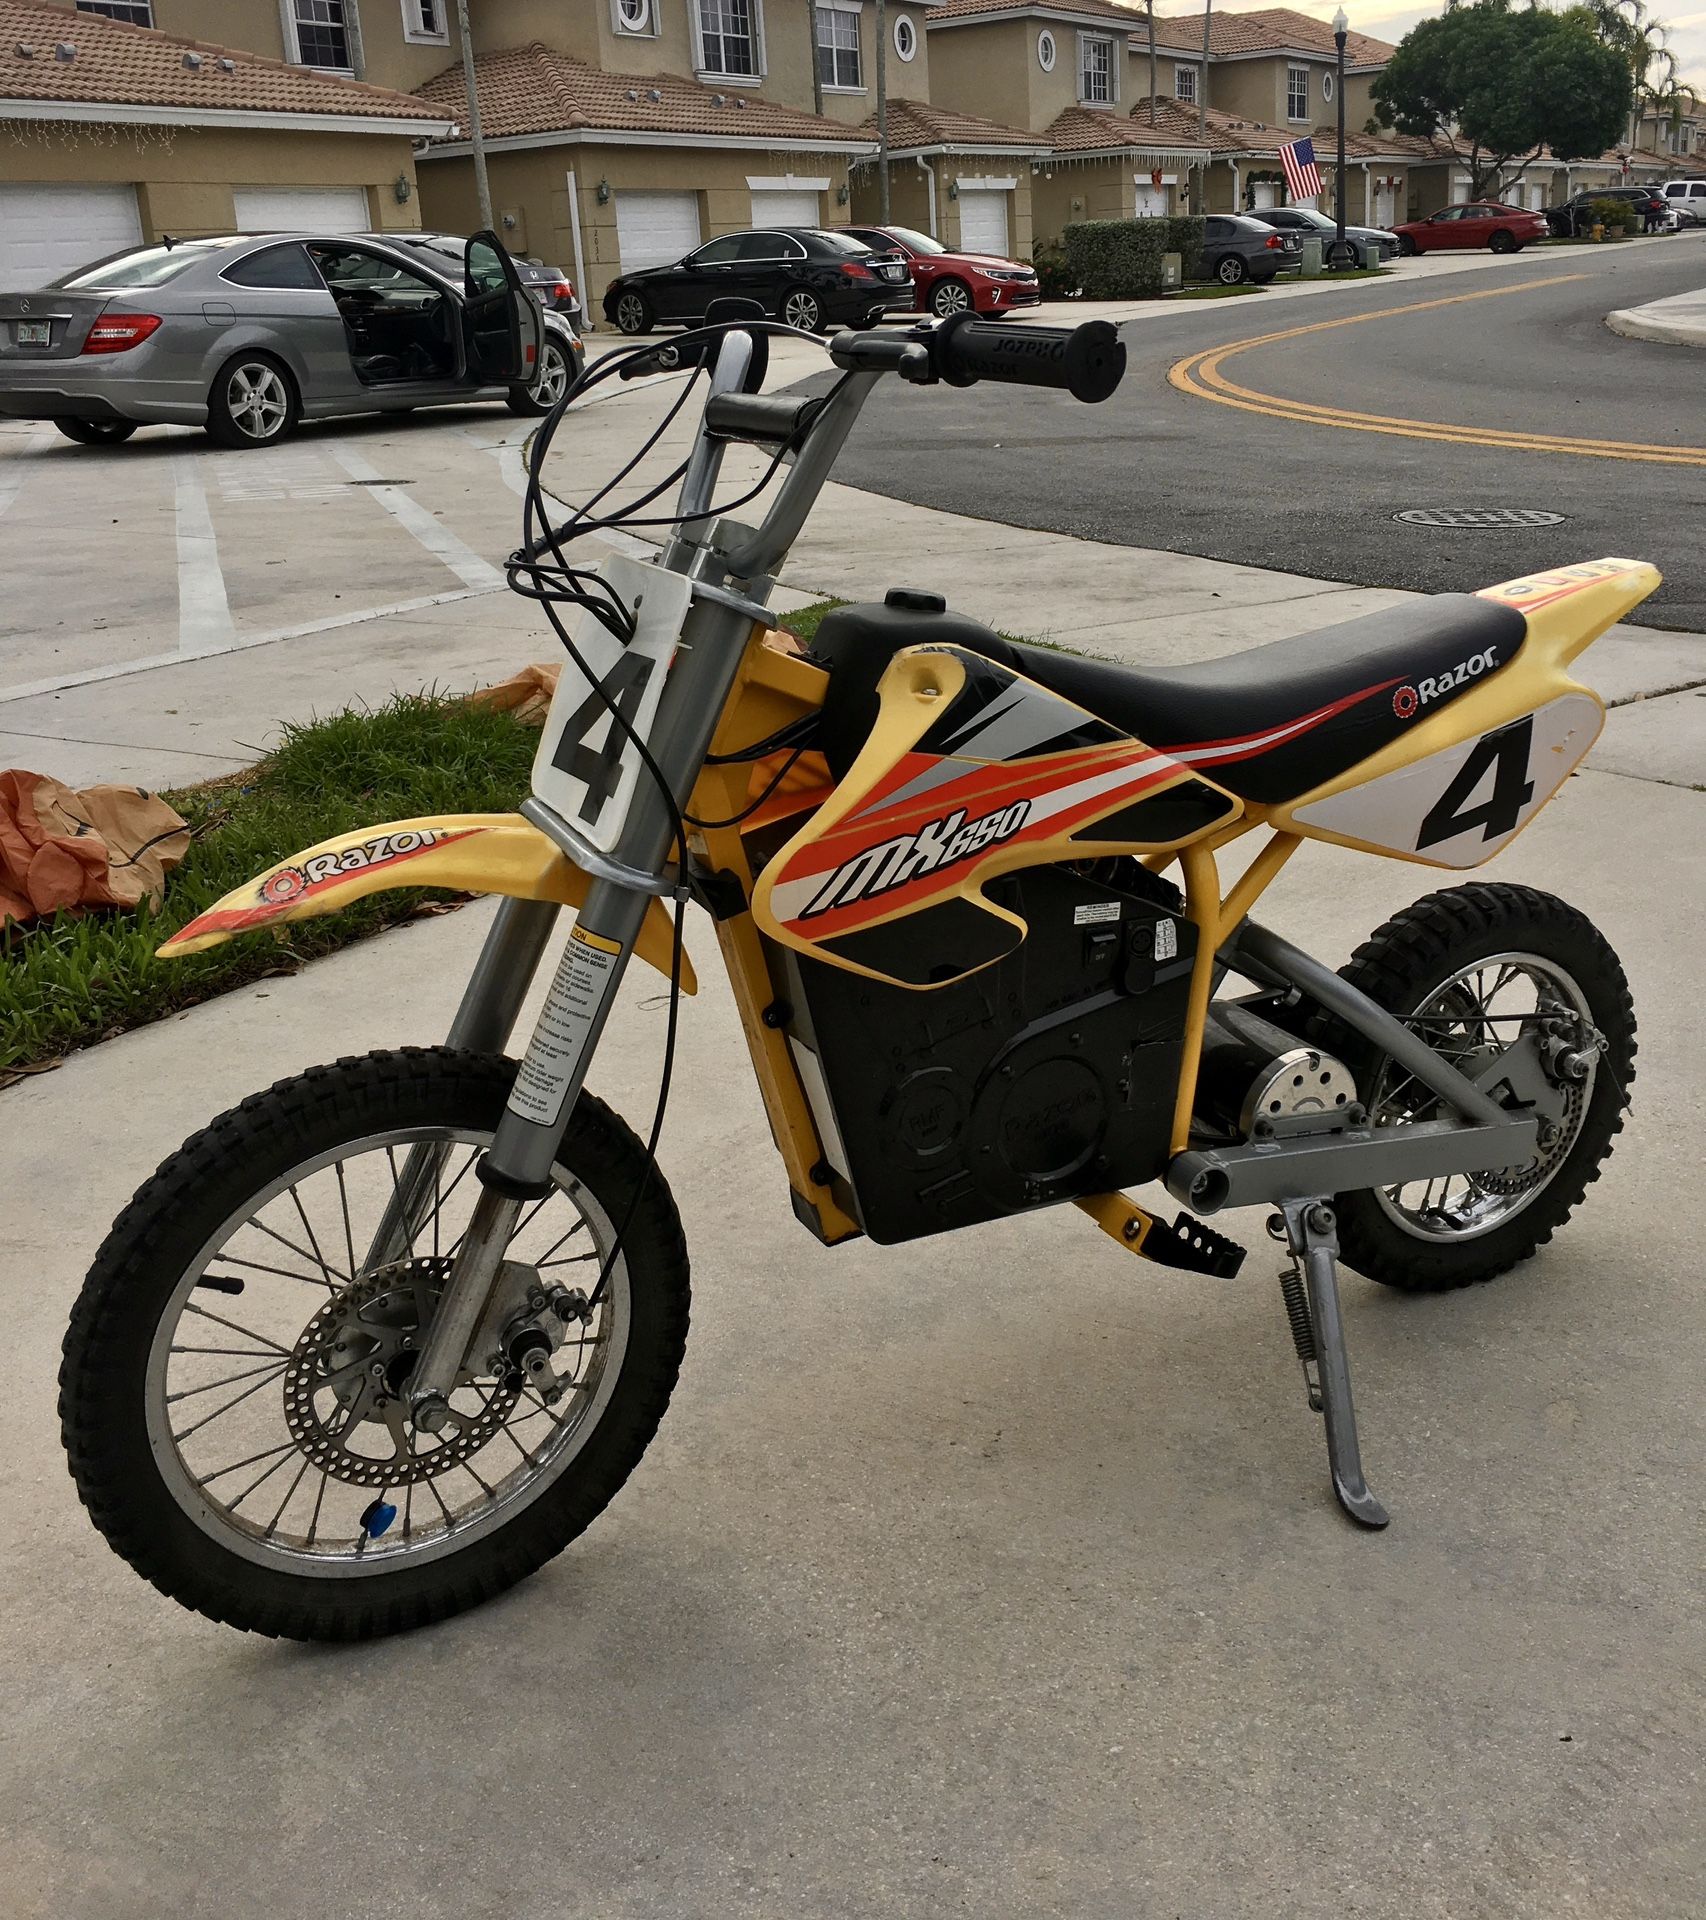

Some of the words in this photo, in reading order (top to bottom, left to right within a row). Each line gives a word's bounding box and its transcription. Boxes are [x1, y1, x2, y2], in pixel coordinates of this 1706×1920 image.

[1418, 645, 1498, 704] Razor
[551, 651, 656, 826] 4
[1415, 713, 1535, 851] 4
[305, 827, 443, 884] Razor
[798, 799, 1032, 919] MX650
